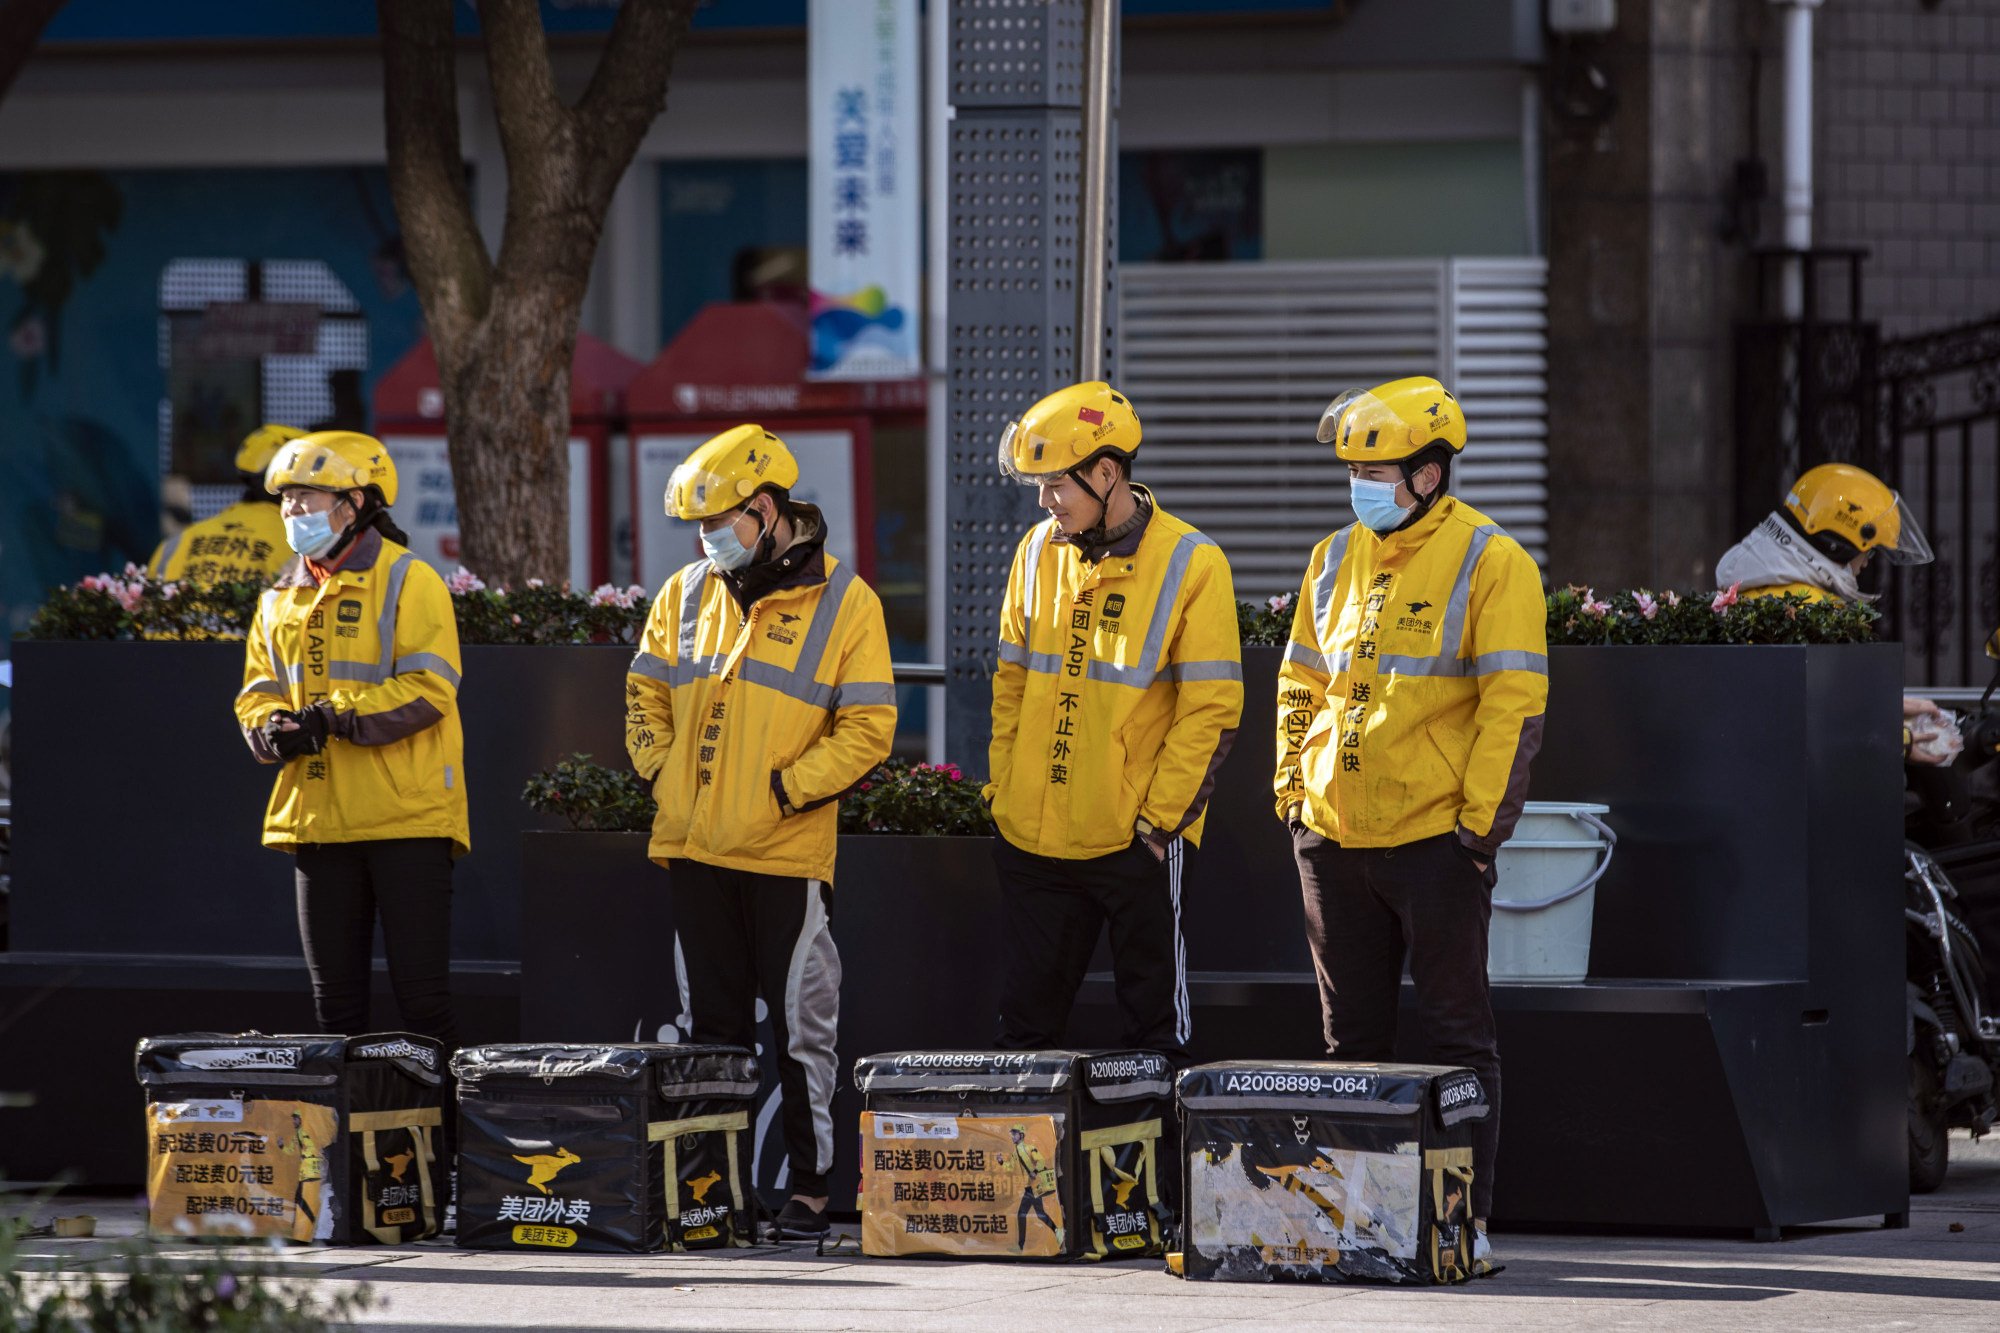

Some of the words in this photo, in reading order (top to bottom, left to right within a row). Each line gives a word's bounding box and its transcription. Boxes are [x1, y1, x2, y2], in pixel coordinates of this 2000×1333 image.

[1099, 619, 1120, 634] 美团
[1357, 572, 1393, 660] 美团外卖
[1396, 617, 1433, 630] 美团外卖
[1050, 692, 1079, 785] 不止外卖
[899, 1054, 1024, 1068] A2008899-074
[1090, 1060, 1161, 1079] A2008899-074
[1226, 1075, 1368, 1093] A2008899-064
[895, 1123, 914, 1134] 美团
[158, 1132, 267, 1155] 配送费0元起
[874, 1149, 985, 1172] 配送费0元起
[176, 1164, 274, 1185] 配送费0元起
[377, 1184, 419, 1207] 美团外卖
[893, 1181, 996, 1202] 配送费0元起
[186, 1195, 284, 1217] 配送费0元起
[497, 1195, 592, 1225] 美团外卖
[905, 1213, 1008, 1235] 配送费0元起
[1105, 1211, 1148, 1235] 美团外卖
[520, 1227, 570, 1244] 美团专送
